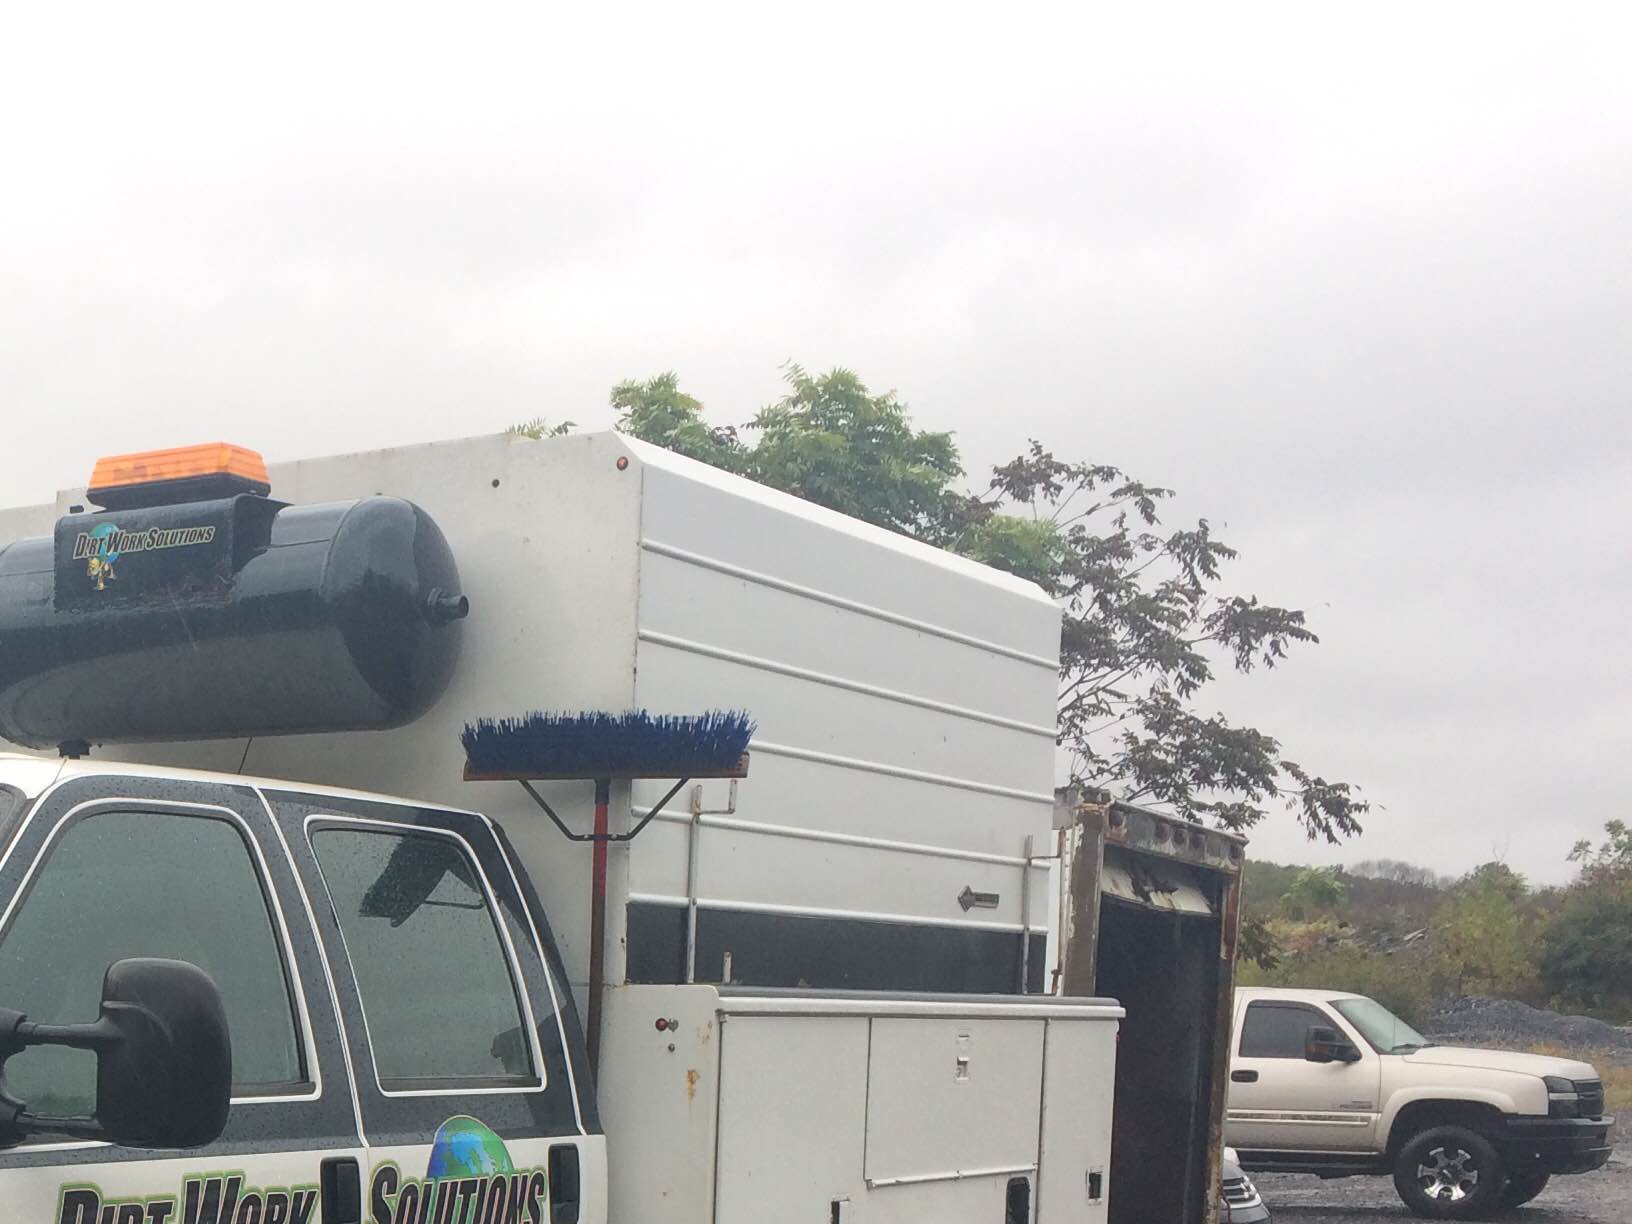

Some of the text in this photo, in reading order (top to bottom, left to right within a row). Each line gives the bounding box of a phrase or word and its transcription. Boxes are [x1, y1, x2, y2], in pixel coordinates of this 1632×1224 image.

[73, 526, 215, 559] DIRT WORK SOLUTIONS
